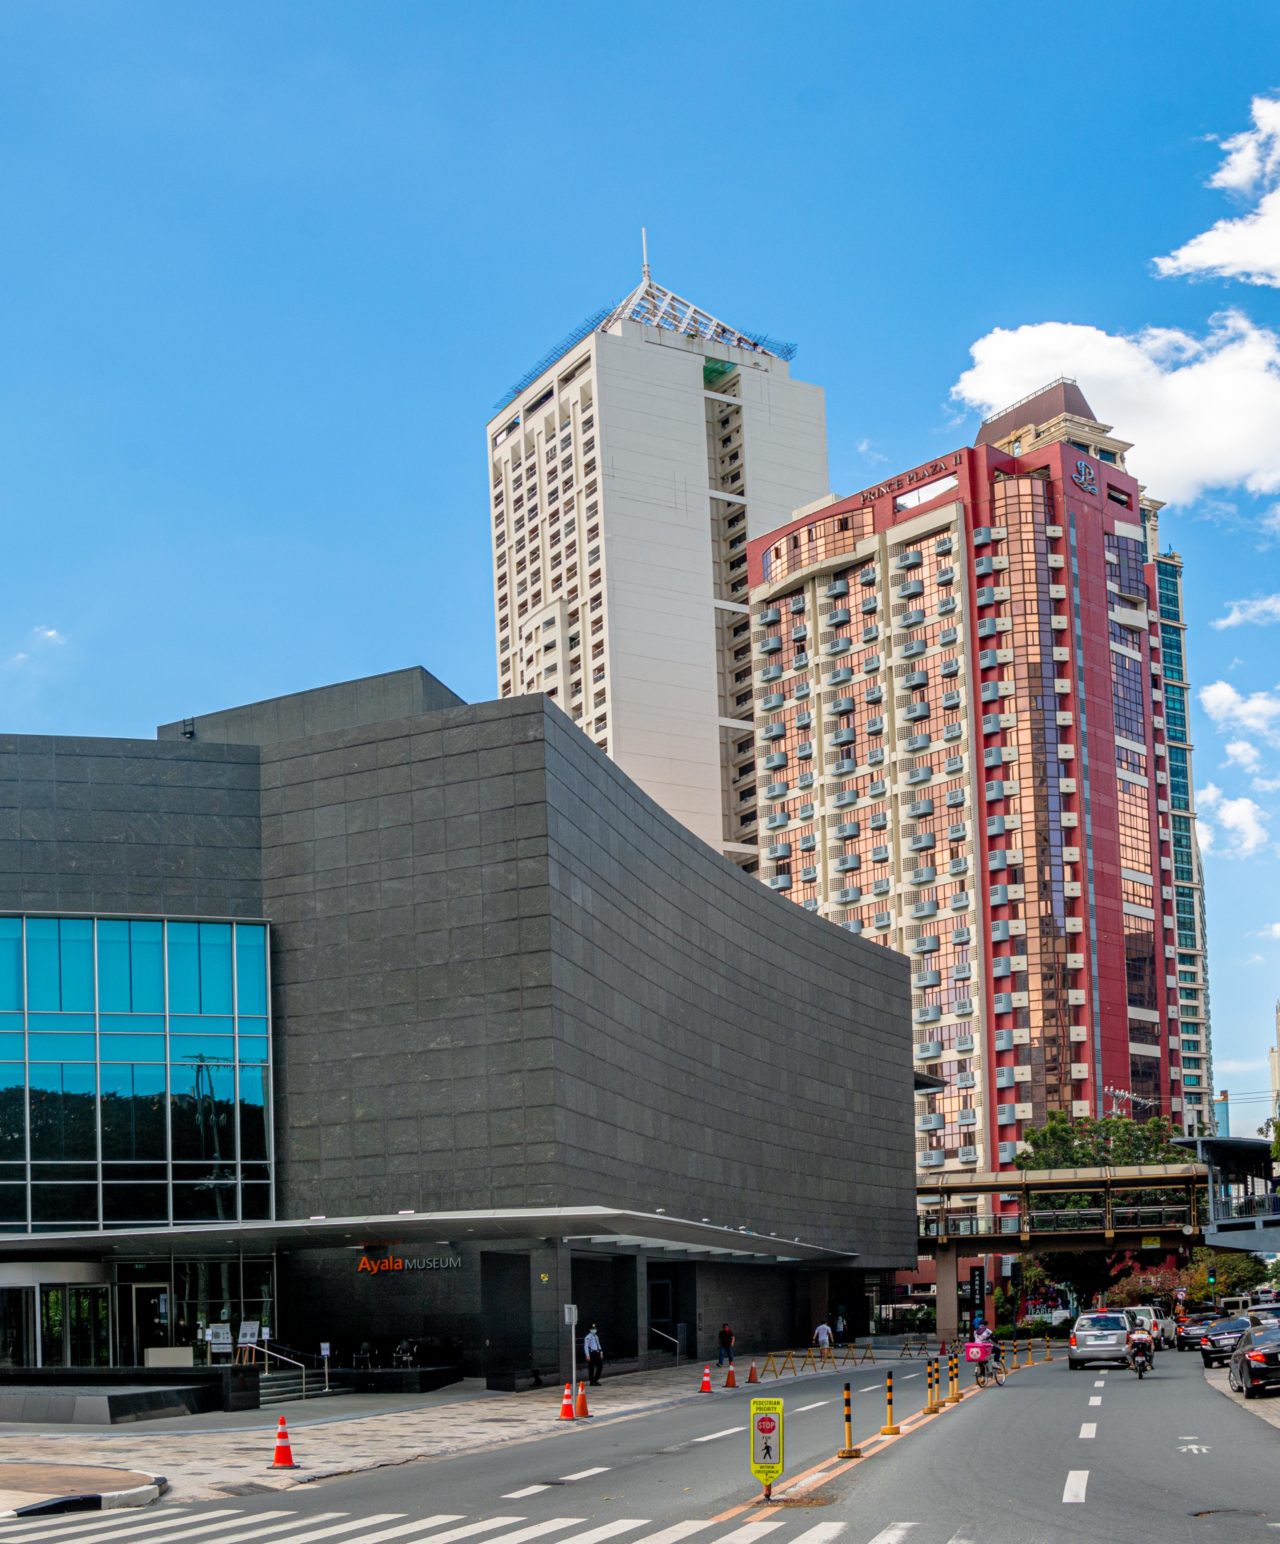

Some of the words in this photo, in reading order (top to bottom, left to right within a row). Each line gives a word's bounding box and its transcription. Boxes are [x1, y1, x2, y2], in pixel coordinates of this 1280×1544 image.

[861, 479, 904, 505] PRINCE
[907, 461, 947, 485] PLAZA
[953, 454, 963, 466] II
[357, 1256, 404, 1275] Ayala
[404, 1257, 462, 1270] MUSEUM
